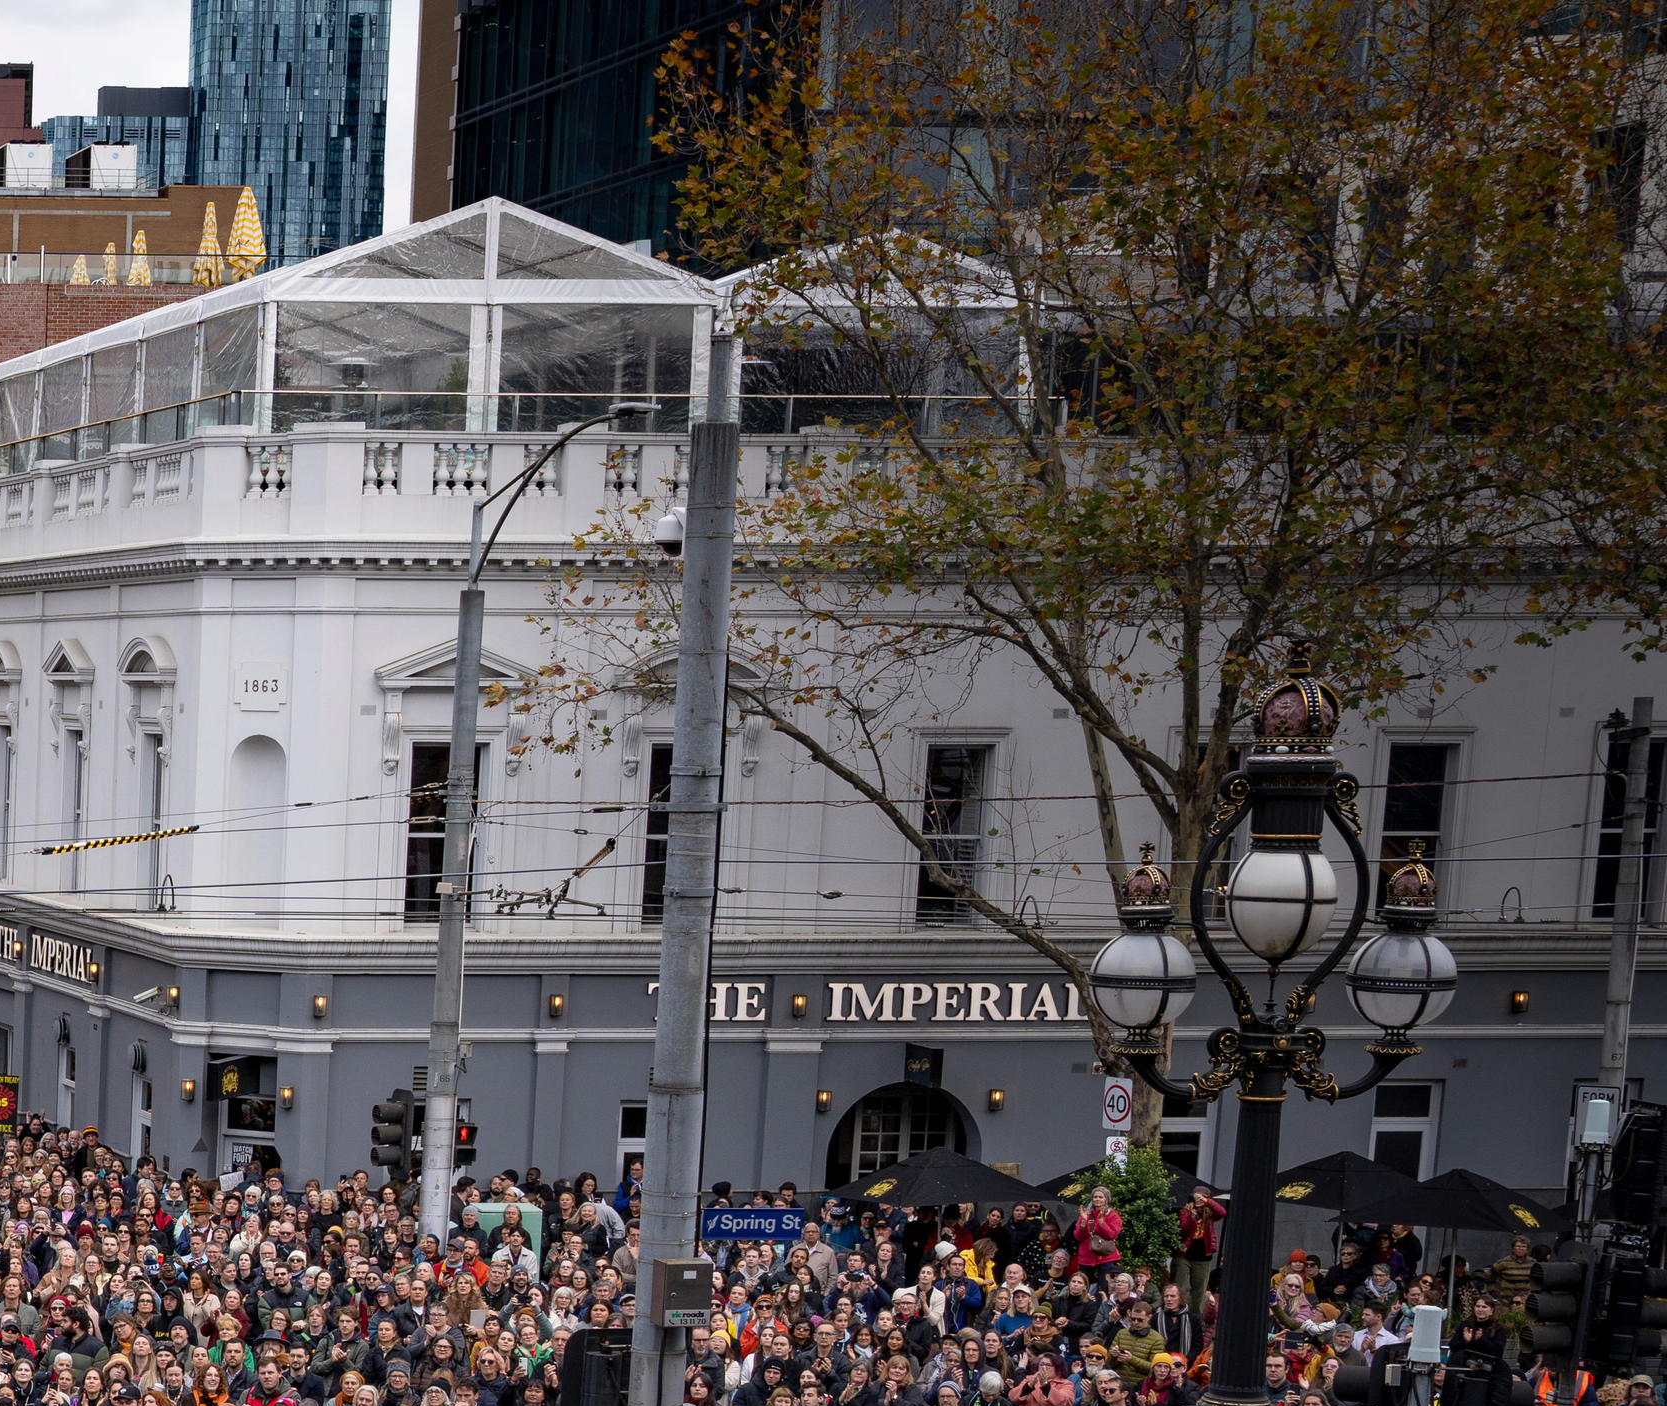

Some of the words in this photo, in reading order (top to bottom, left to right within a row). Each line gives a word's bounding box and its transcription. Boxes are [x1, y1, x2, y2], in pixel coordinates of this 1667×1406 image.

[244, 679, 279, 693] 1863
[647, 983, 766, 1021] HE
[825, 983, 1090, 1022] IMPERIAL
[1107, 1094, 1127, 1114] 40
[720, 1214, 776, 1233] Spring
[781, 1213, 800, 1229] St
